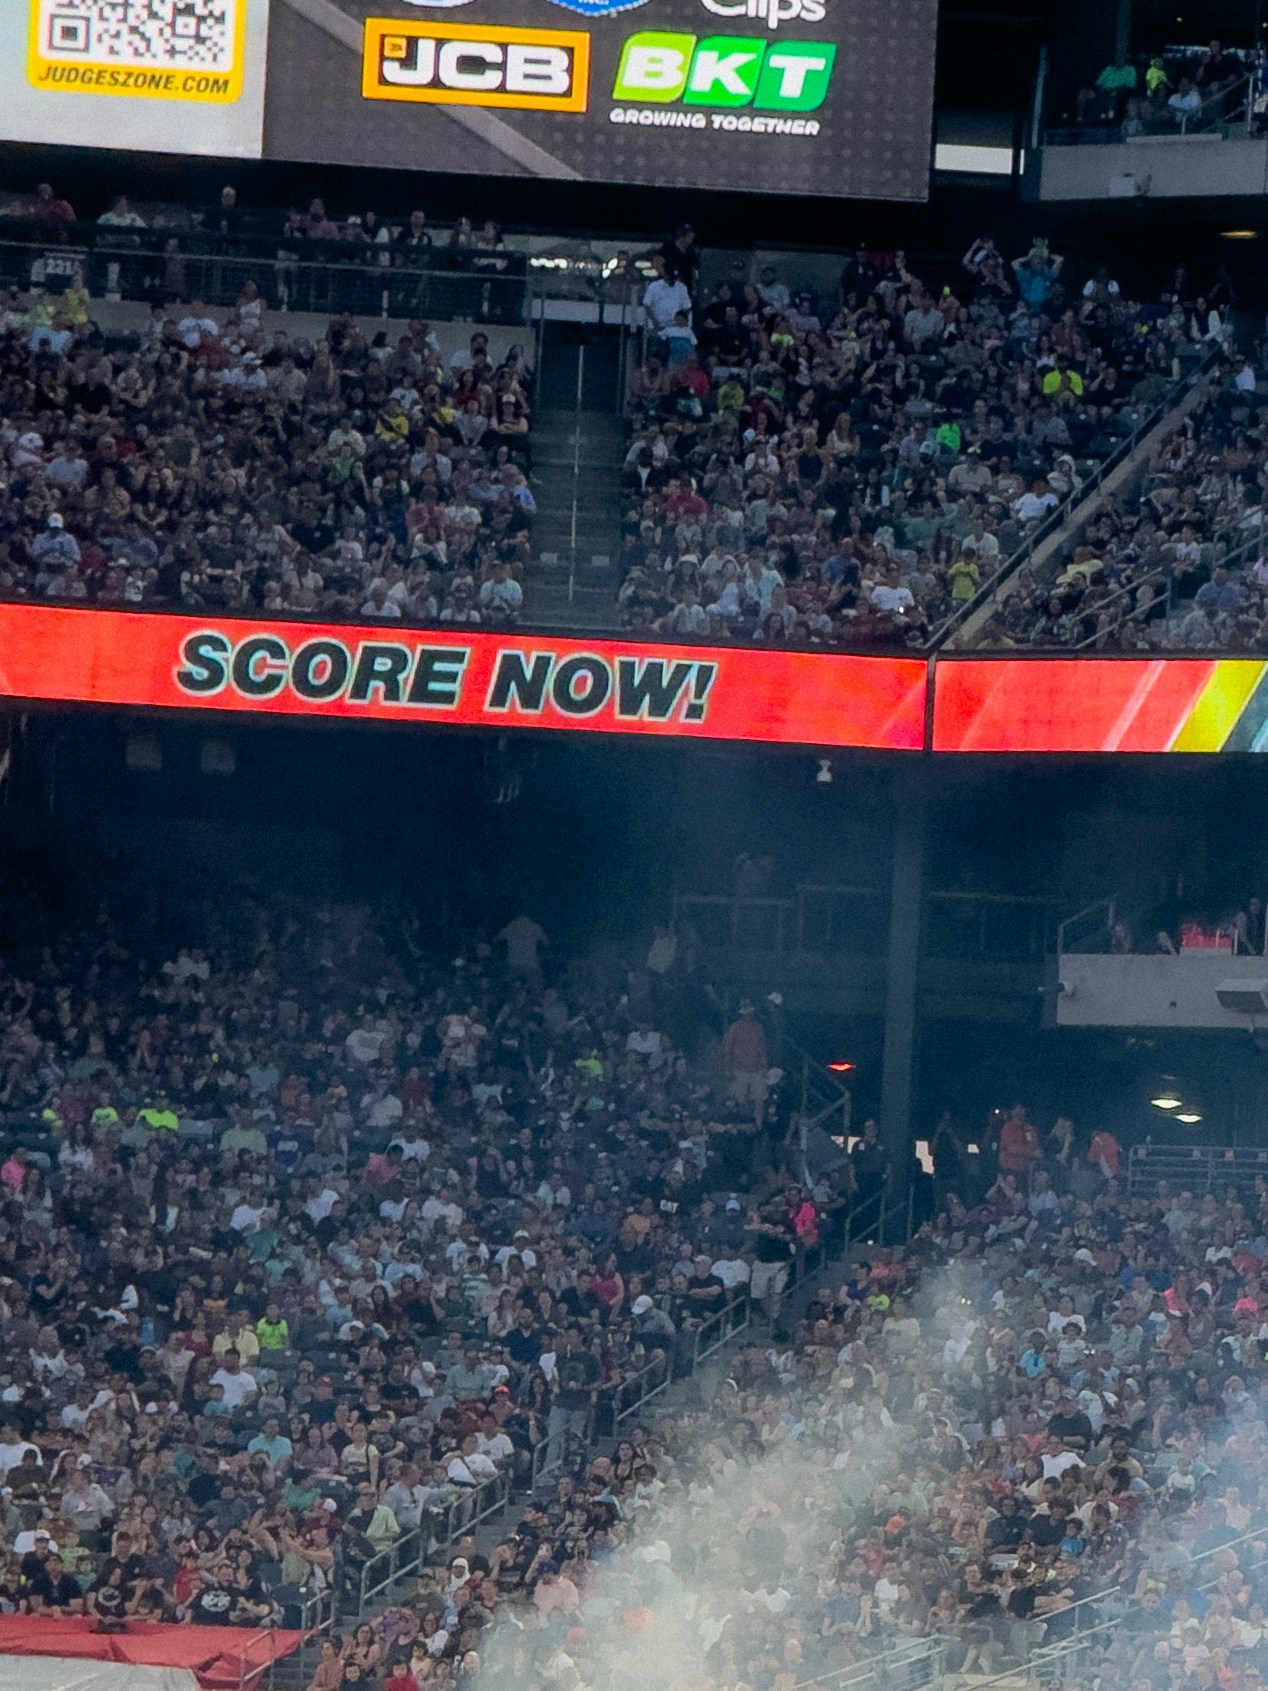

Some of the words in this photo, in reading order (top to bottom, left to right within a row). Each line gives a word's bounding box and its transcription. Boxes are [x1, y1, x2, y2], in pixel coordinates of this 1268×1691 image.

[38, 66, 230, 94] JUDGESZONE.COM
[382, 37, 570, 95] JCB
[621, 45, 827, 99] BKT
[608, 107, 707, 129] GROWING
[711, 114, 821, 136] TOGETHER
[174, 629, 472, 710] SCORE
[484, 648, 718, 724] NOW!
